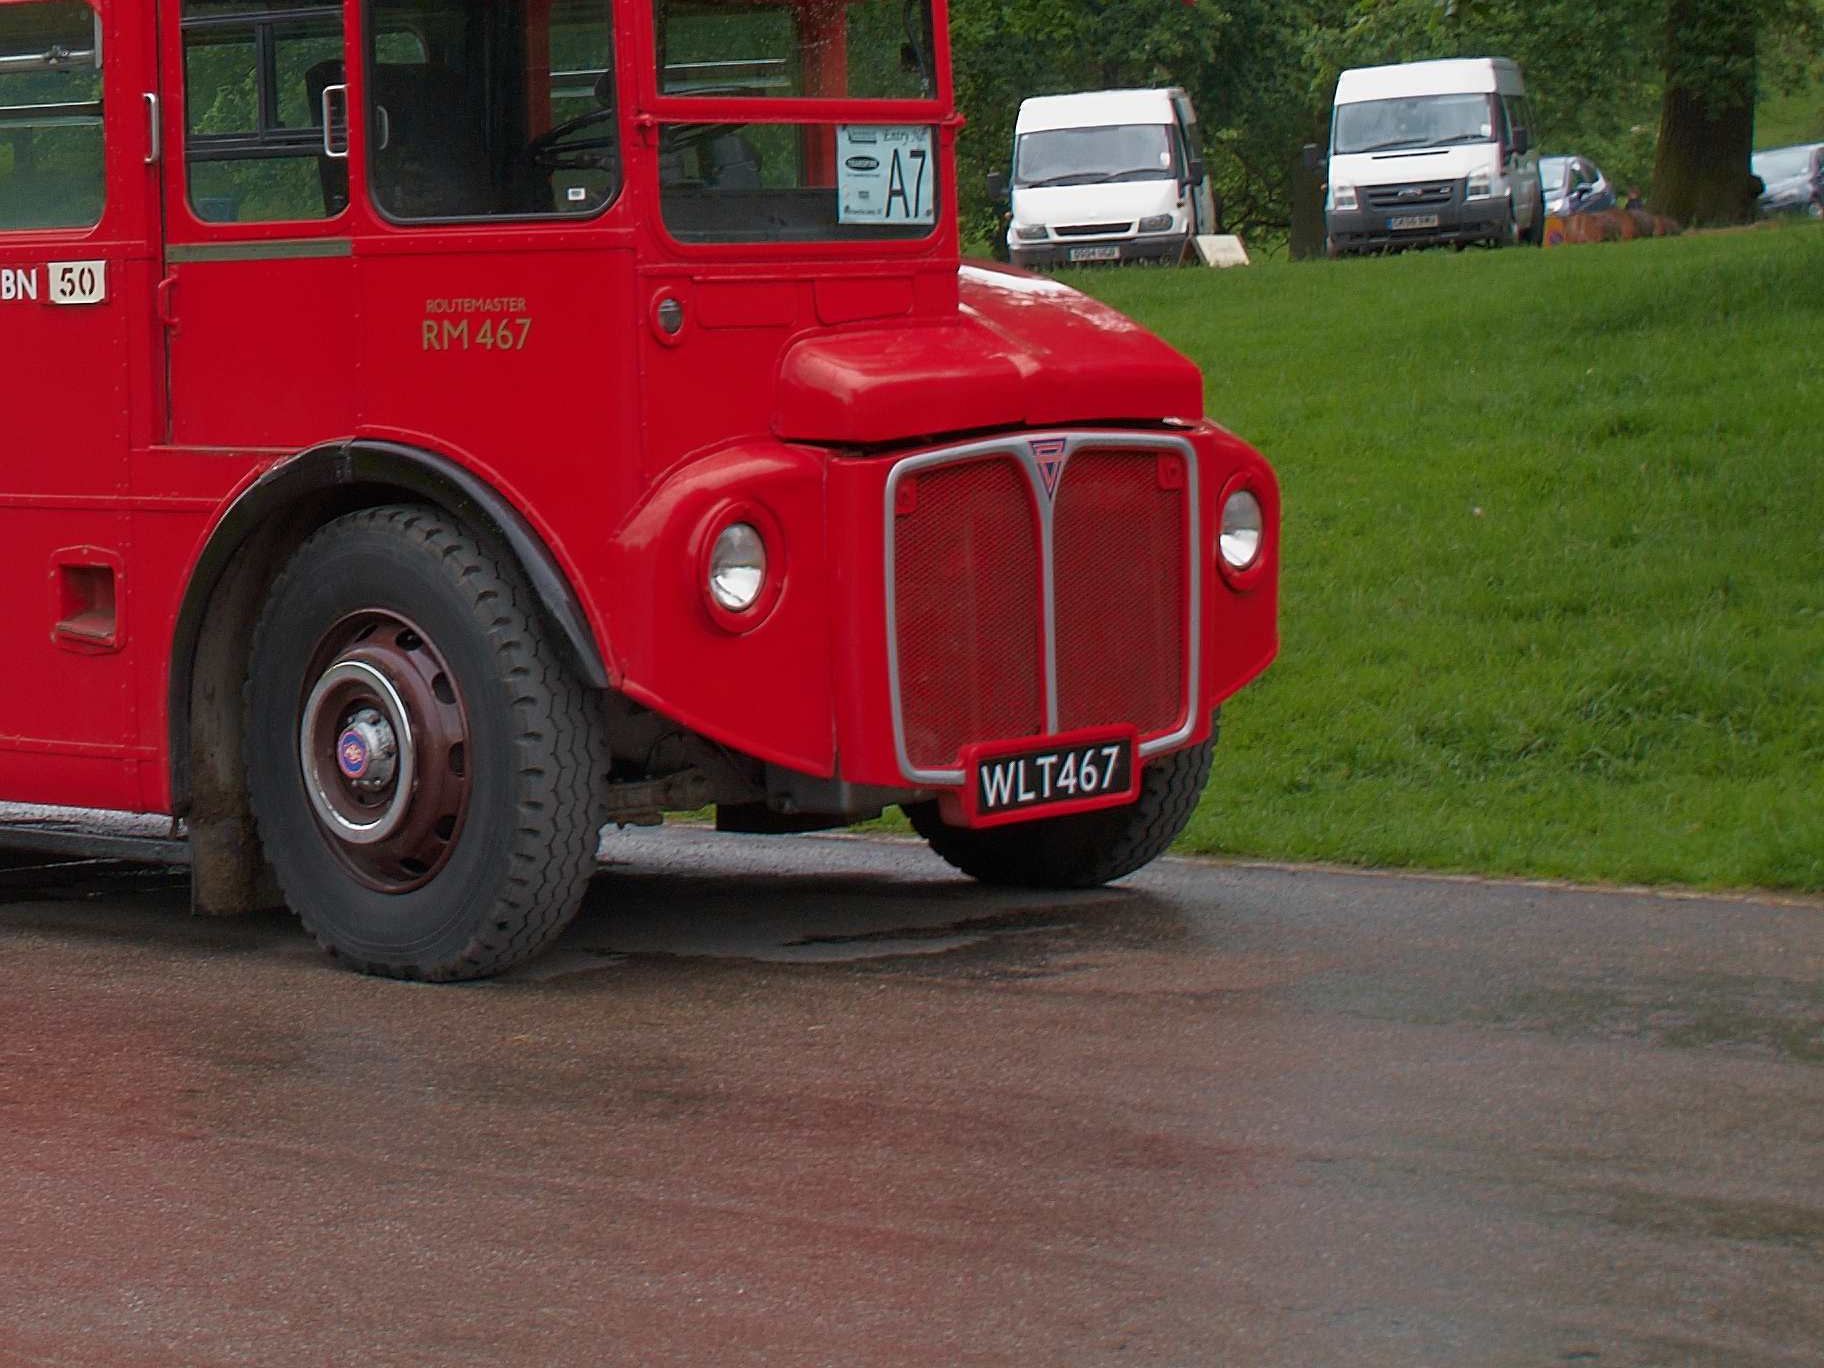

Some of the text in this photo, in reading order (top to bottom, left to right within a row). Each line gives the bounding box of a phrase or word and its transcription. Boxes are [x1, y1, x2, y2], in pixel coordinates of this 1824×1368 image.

[885, 148, 927, 219] A7
[1, 267, 95, 300] BN 50
[426, 297, 526, 313] ROUTEMASTER
[980, 744, 1121, 808] WLT467
